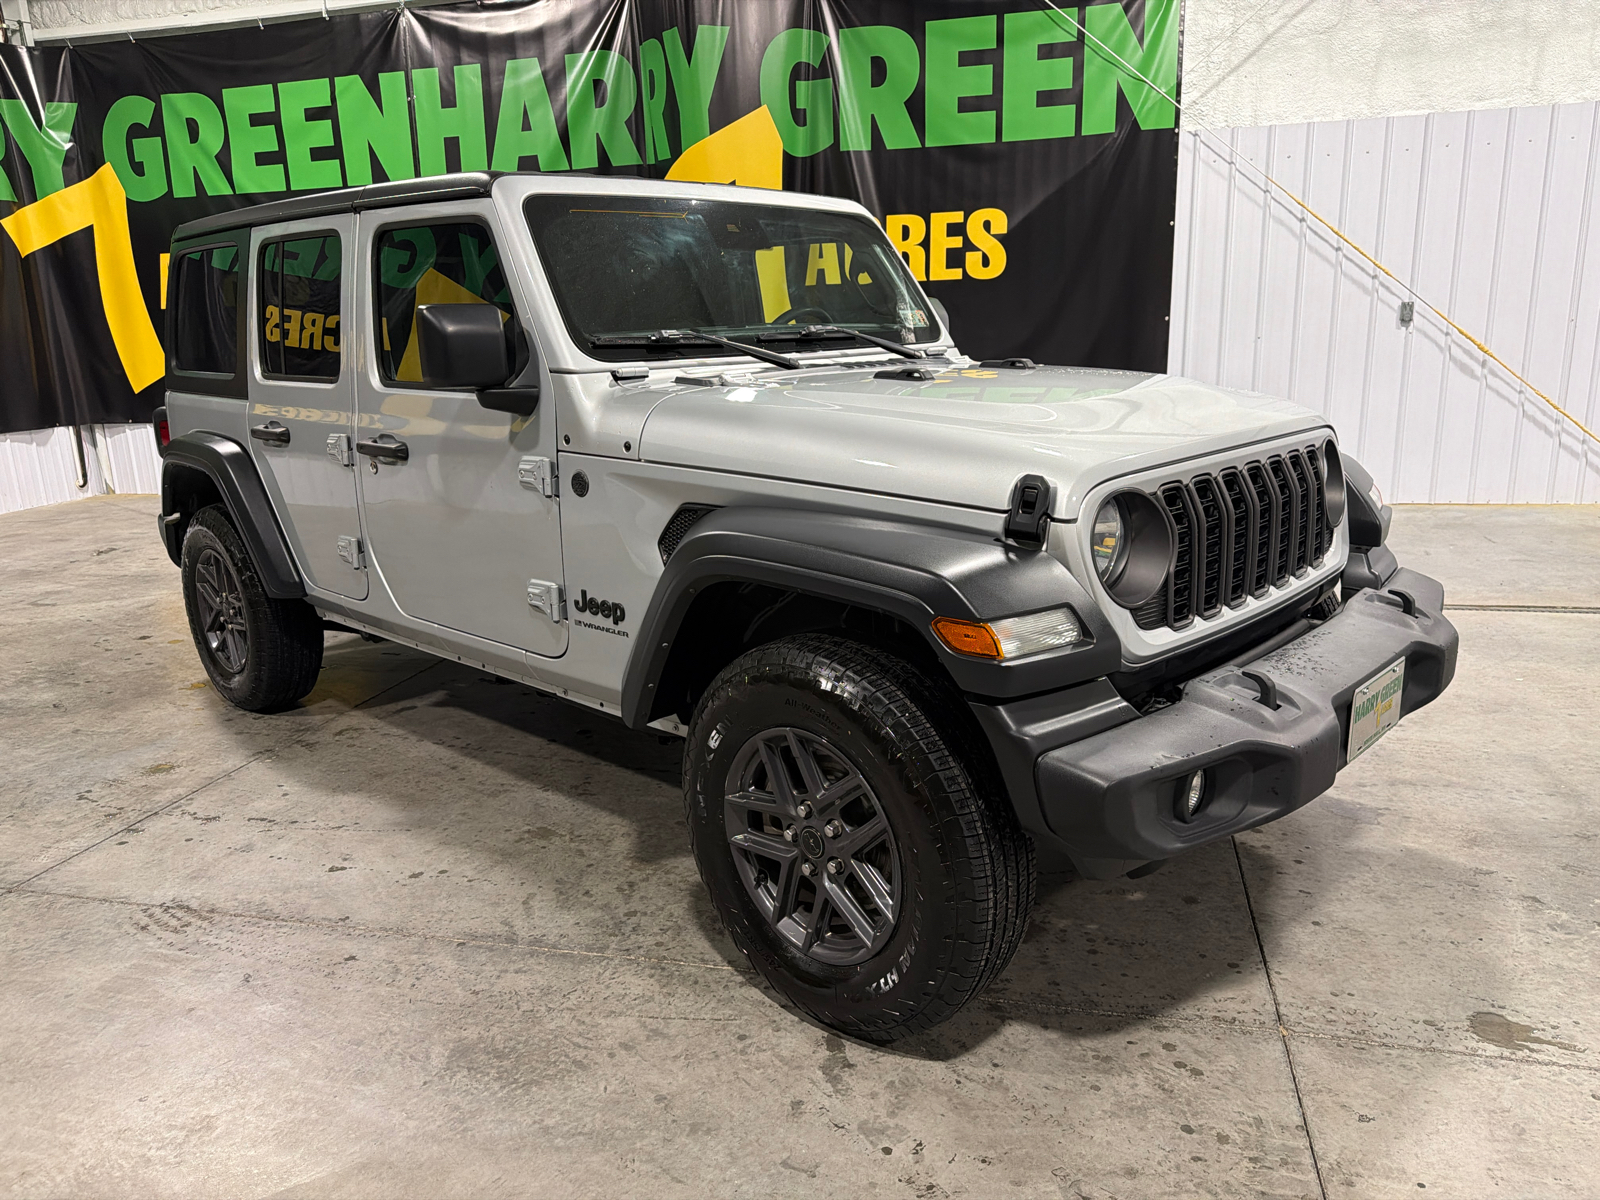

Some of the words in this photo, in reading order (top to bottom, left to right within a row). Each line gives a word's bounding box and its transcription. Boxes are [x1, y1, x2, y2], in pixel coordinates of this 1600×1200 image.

[411, 25, 730, 178] HARRY
[759, 0, 1179, 157] GREEN
[102, 71, 416, 202] GREEN
[573, 588, 626, 626] Jeep
[582, 621, 630, 639] WRANGLER
[783, 697, 842, 731] All-Weather
[1354, 689, 1381, 724] HARRY
[1380, 673, 1403, 703] GREEN
